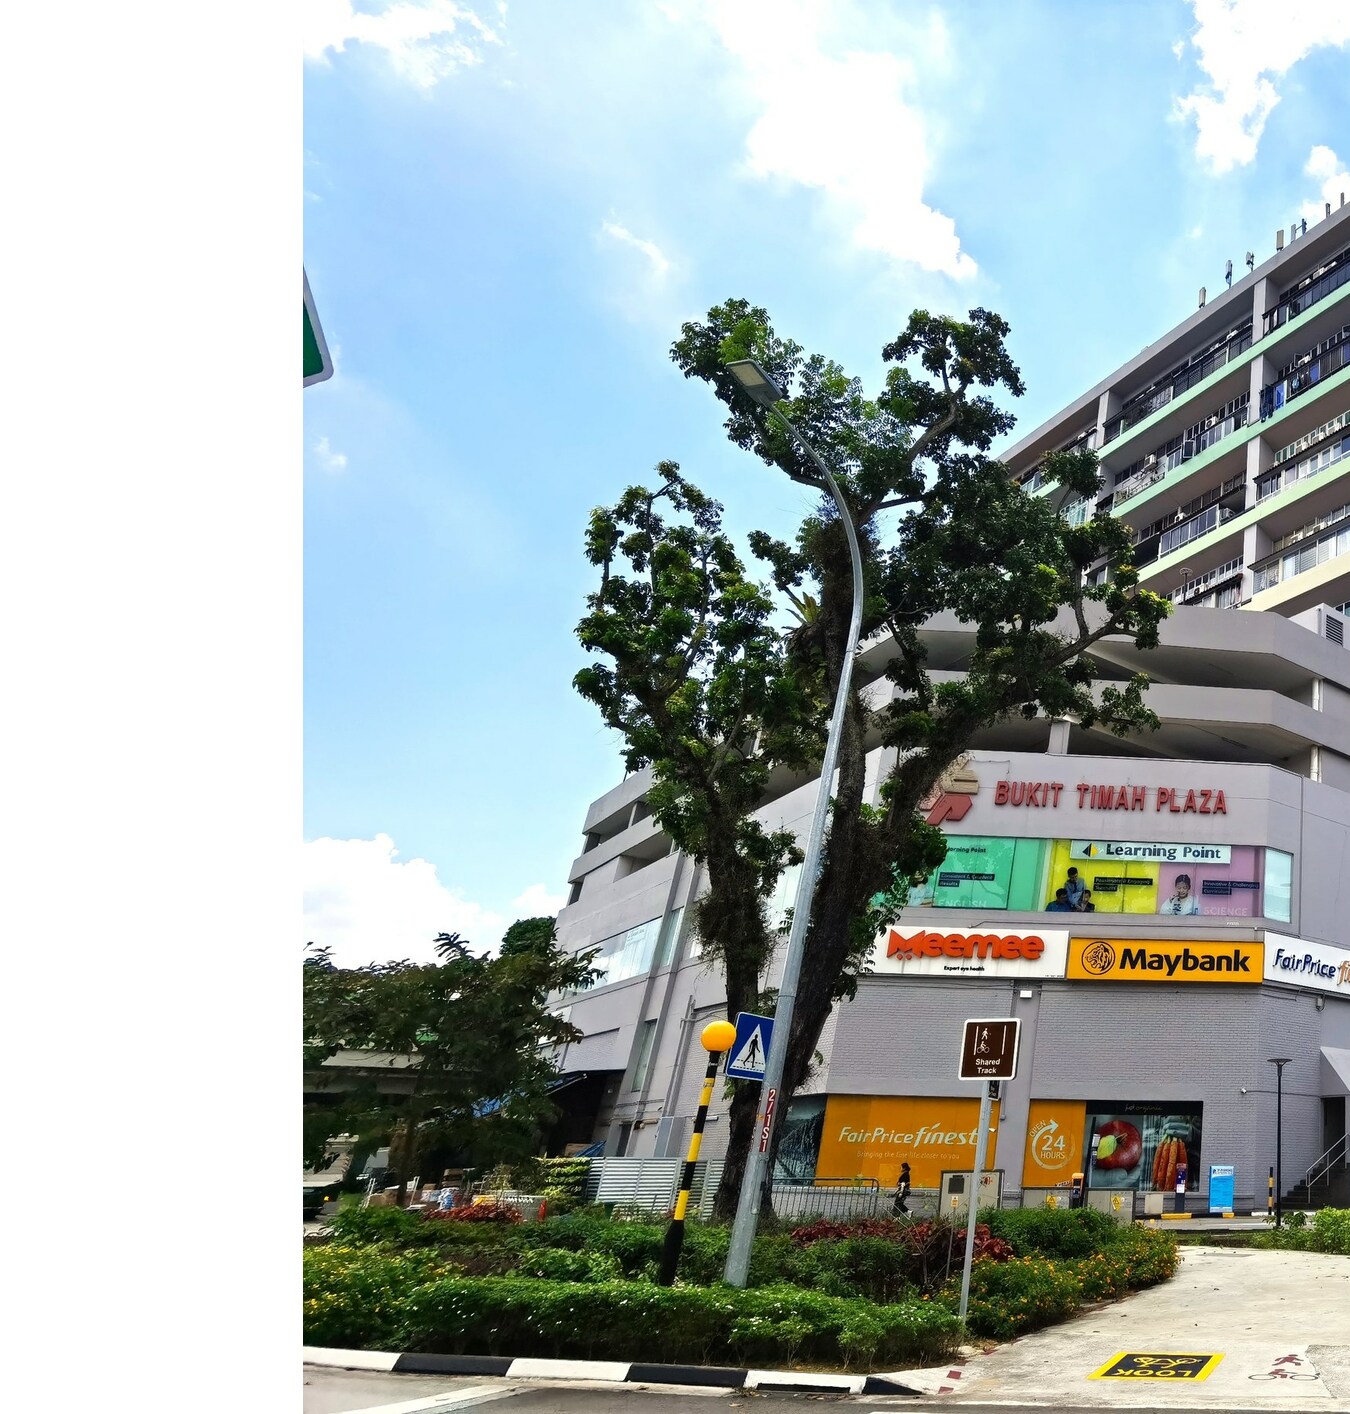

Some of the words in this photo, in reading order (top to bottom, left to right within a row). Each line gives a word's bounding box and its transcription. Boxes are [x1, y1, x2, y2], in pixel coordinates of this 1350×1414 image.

[994, 780, 1064, 807] BUKIT
[1077, 783, 1147, 811] TIMAH
[1156, 787, 1227, 814] PLAZA
[1106, 843, 1177, 861] Learning
[1182, 844, 1222, 859] Point
[1203, 906, 1248, 916] SCIENCE
[887, 929, 1045, 960] Meemee
[1119, 948, 1250, 976] Maybank
[1273, 948, 1337, 979] FairPrice
[975, 1058, 1001, 1066] Shared
[838, 1126, 914, 1144] FairPrice
[913, 1122, 980, 1148] finest
[1029, 1119, 1047, 1137] OPEN
[1041, 1134, 1066, 1151] 24
[1040, 1151, 1066, 1159] HOURS
[1112, 1369, 1193, 1377] LOOK
